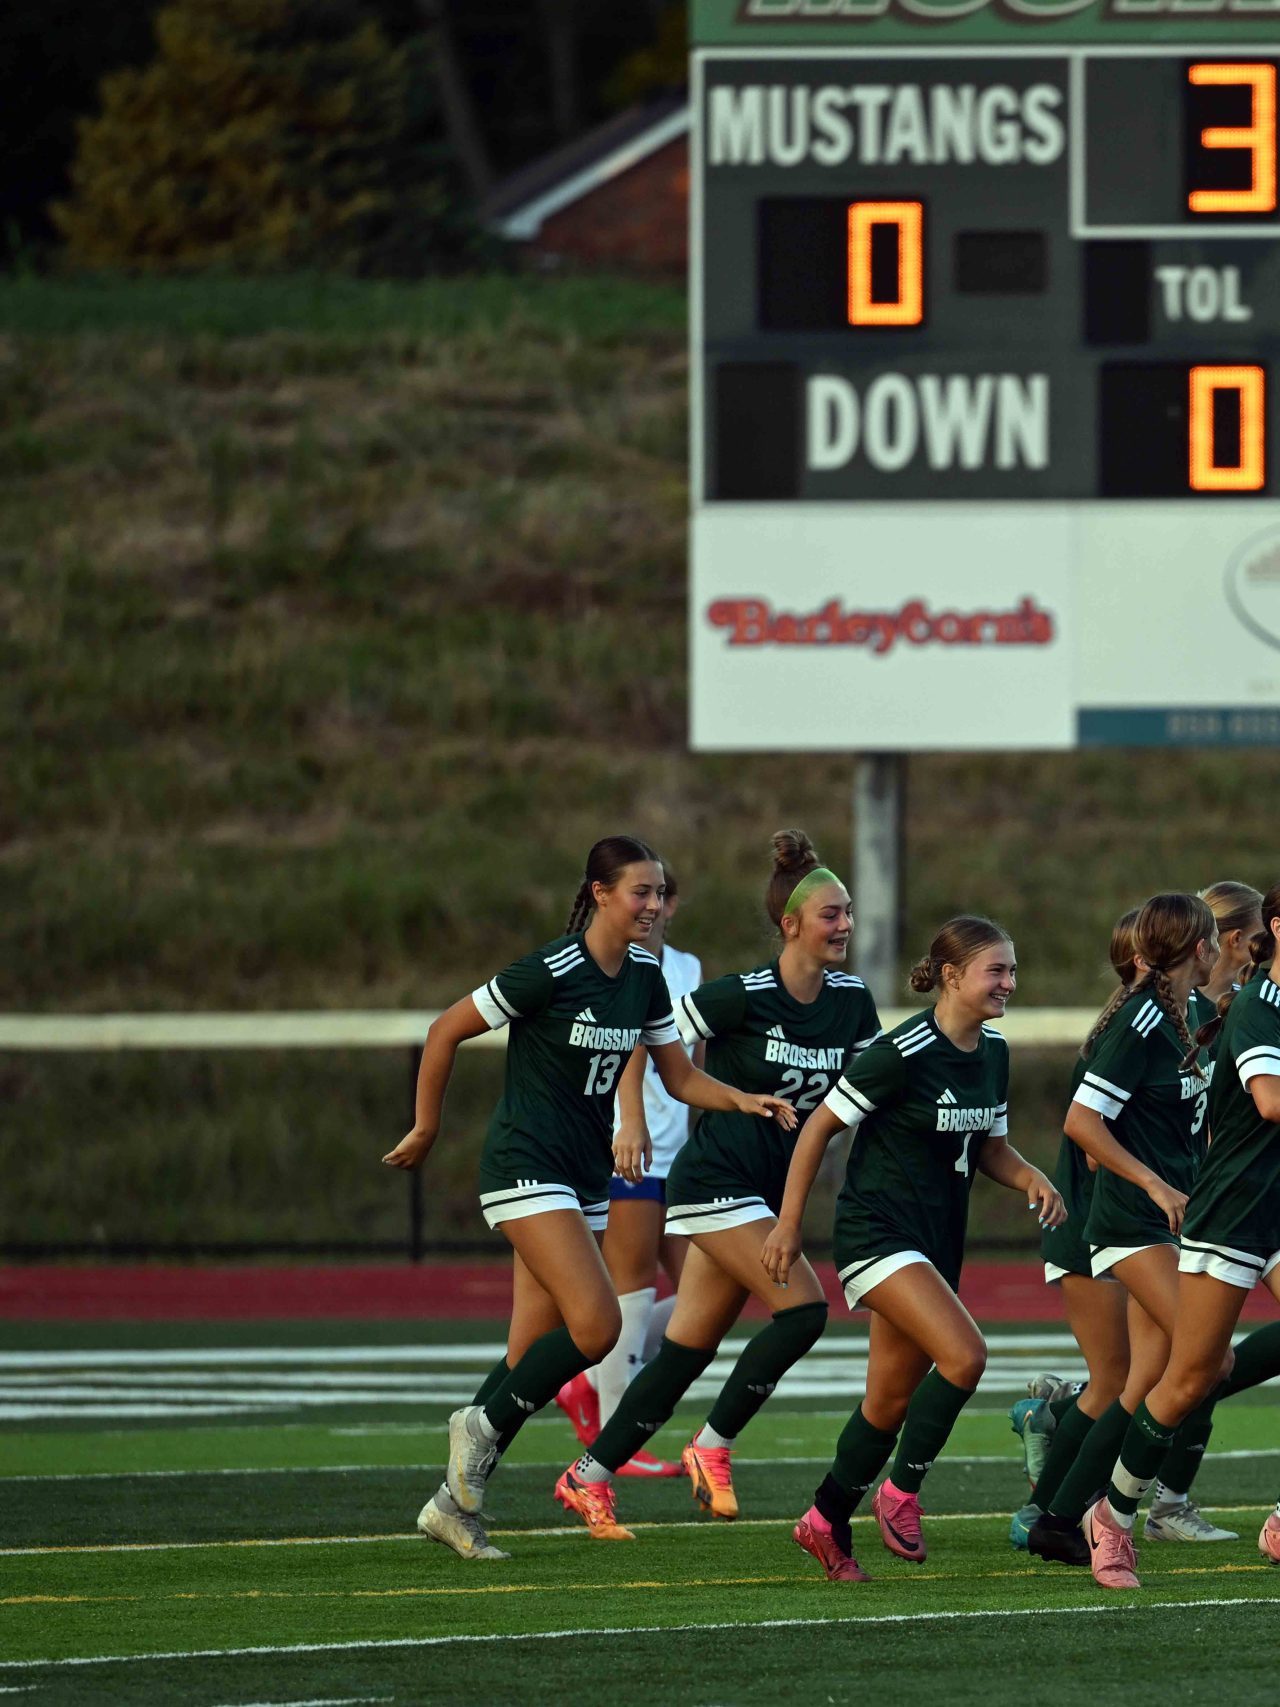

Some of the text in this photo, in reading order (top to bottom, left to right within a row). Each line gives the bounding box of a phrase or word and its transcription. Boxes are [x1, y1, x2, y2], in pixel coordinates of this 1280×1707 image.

[710, 84, 1064, 166] MUSTANGS
[847, 201, 923, 325] 0
[1155, 265, 1252, 322] TOL
[806, 372, 1049, 471] DOWN
[1188, 365, 1265, 490] 0
[568, 1022, 642, 1052] BROSSART
[765, 1038, 845, 1070] BROSSART
[584, 1053, 621, 1096] 13
[773, 1068, 830, 1110] 22
[936, 1107, 997, 1132] BROSSAR
[1190, 1090, 1208, 1136] 3
[954, 1132, 973, 1178] 4
